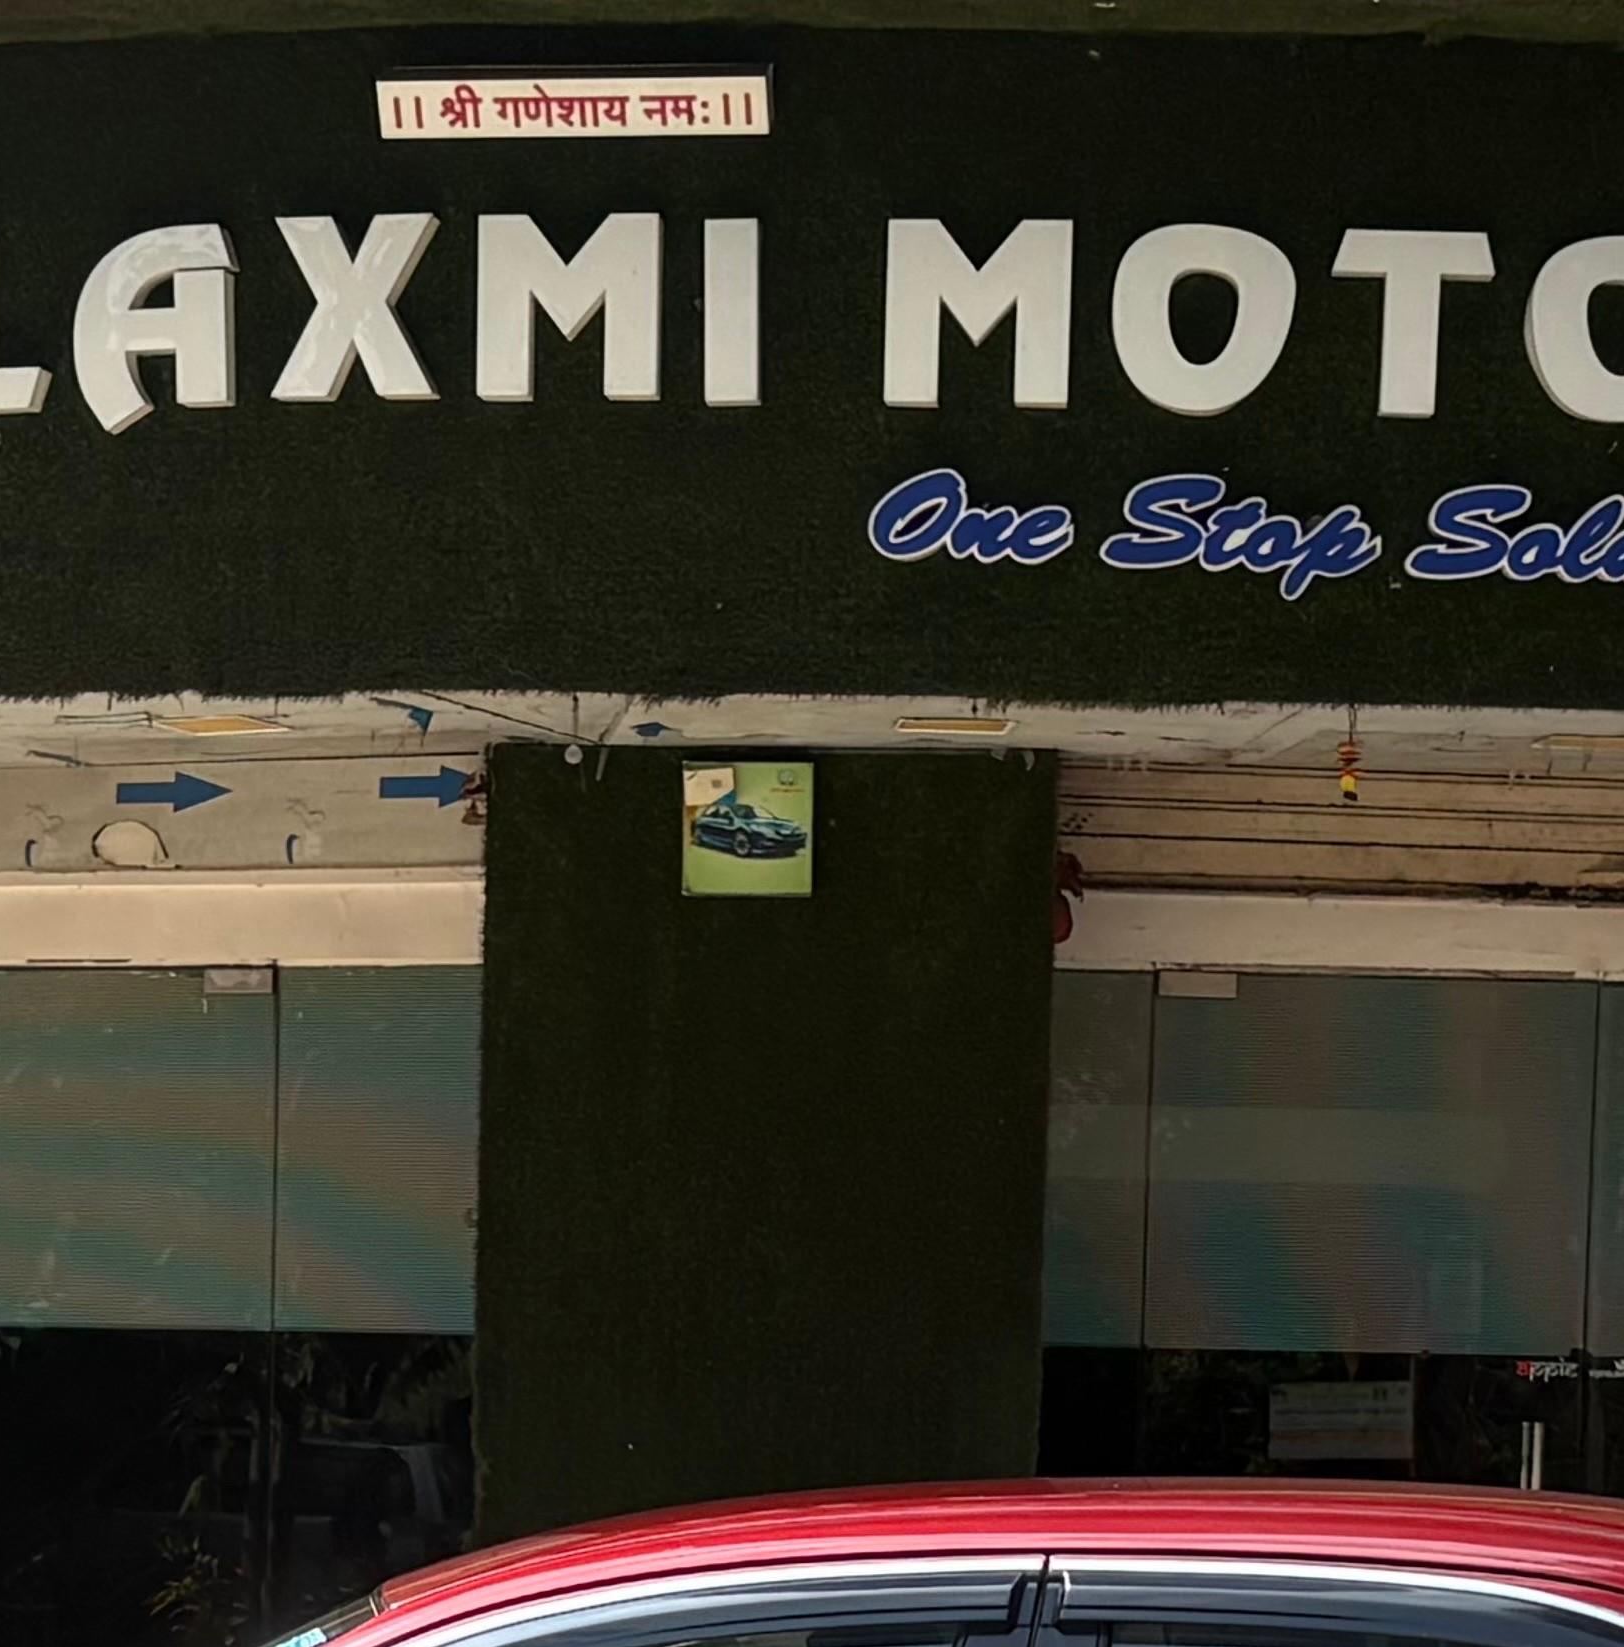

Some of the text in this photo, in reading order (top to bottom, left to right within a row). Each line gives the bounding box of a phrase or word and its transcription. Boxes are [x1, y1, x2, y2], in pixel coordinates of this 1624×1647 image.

[439, 83, 482, 128] श्री
[492, 83, 631, 128] गणेशाय
[868, 468, 1074, 565] One
[1100, 473, 1382, 600] Stop
